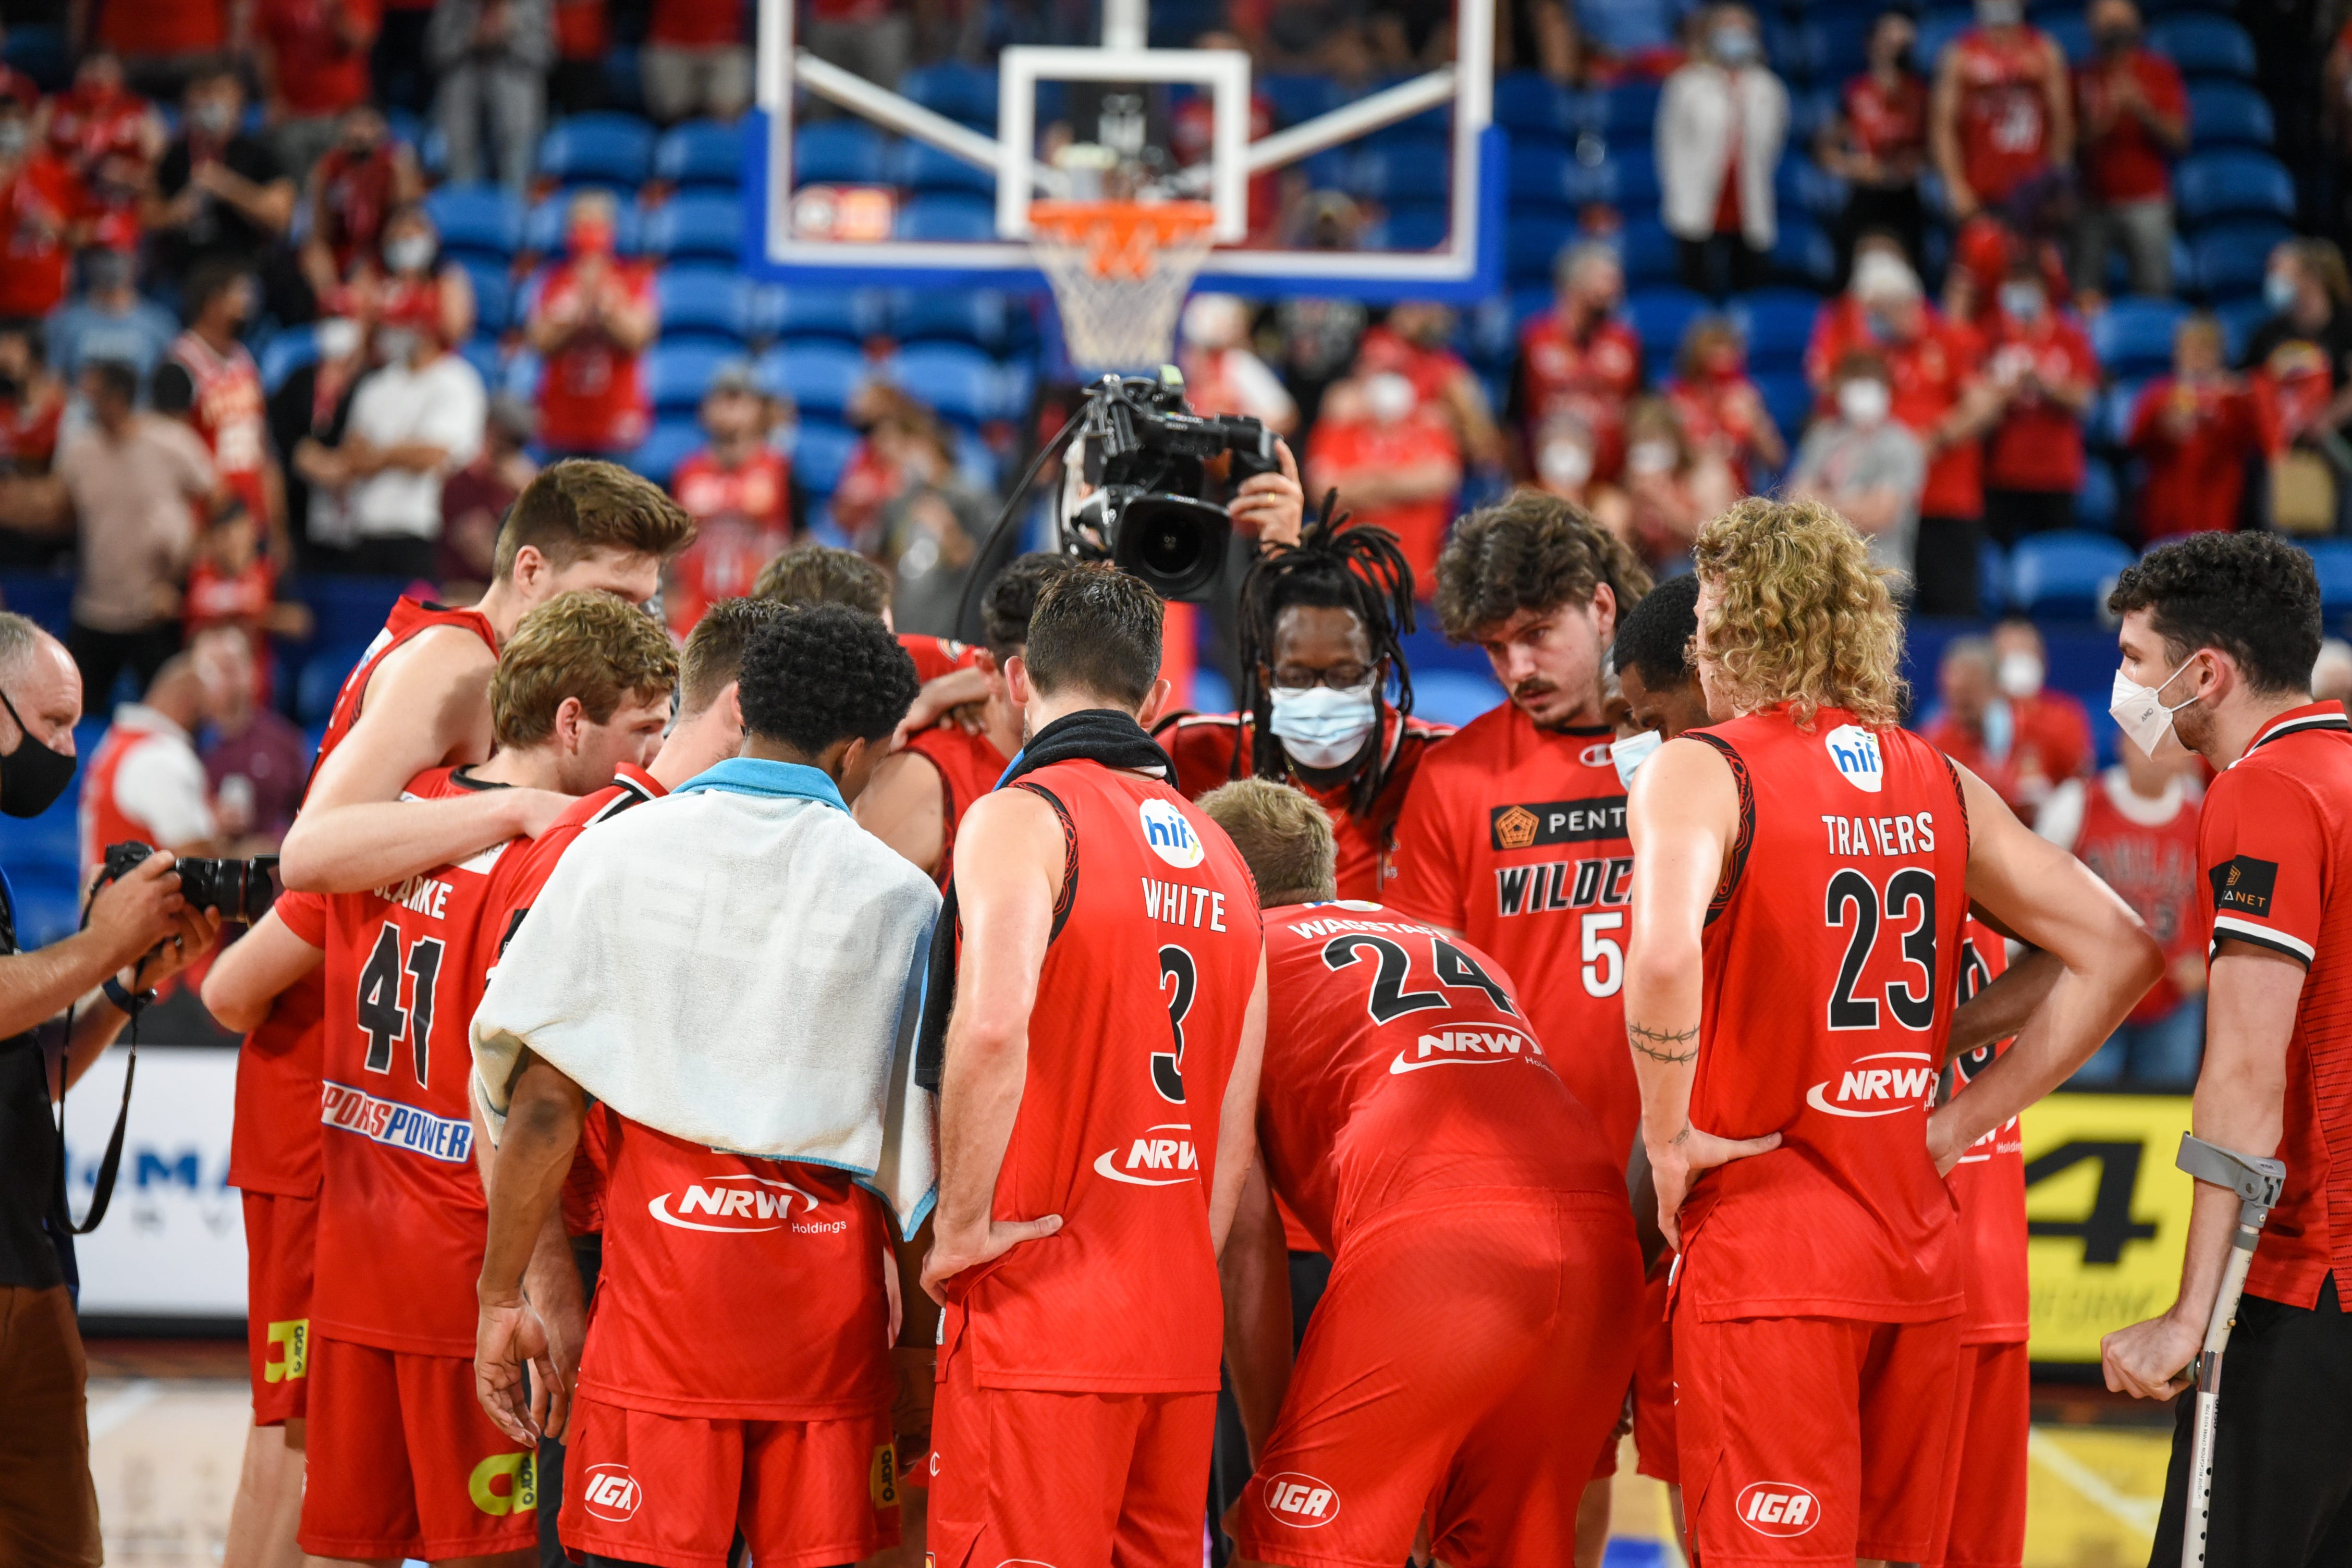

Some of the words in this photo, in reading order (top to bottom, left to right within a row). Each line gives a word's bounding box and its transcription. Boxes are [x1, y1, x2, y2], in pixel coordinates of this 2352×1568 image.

[1832, 741, 1879, 773] hif
[1144, 814, 1188, 850] hif
[1141, 876, 1228, 934] WHITE
[1494, 855, 1635, 917] WILDC
[1580, 911, 1624, 998] 5
[1824, 867, 1937, 1032] 23
[1320, 932, 1521, 1027] 24
[357, 920, 446, 1091] 41
[1149, 944, 1198, 1105] 3
[1417, 1031, 1523, 1059] NRW
[678, 1184, 794, 1220] NRW
[791, 1219, 847, 1235] Holdings
[1270, 1481, 1332, 1517] IGA
[1745, 1490, 1809, 1526] IGA
